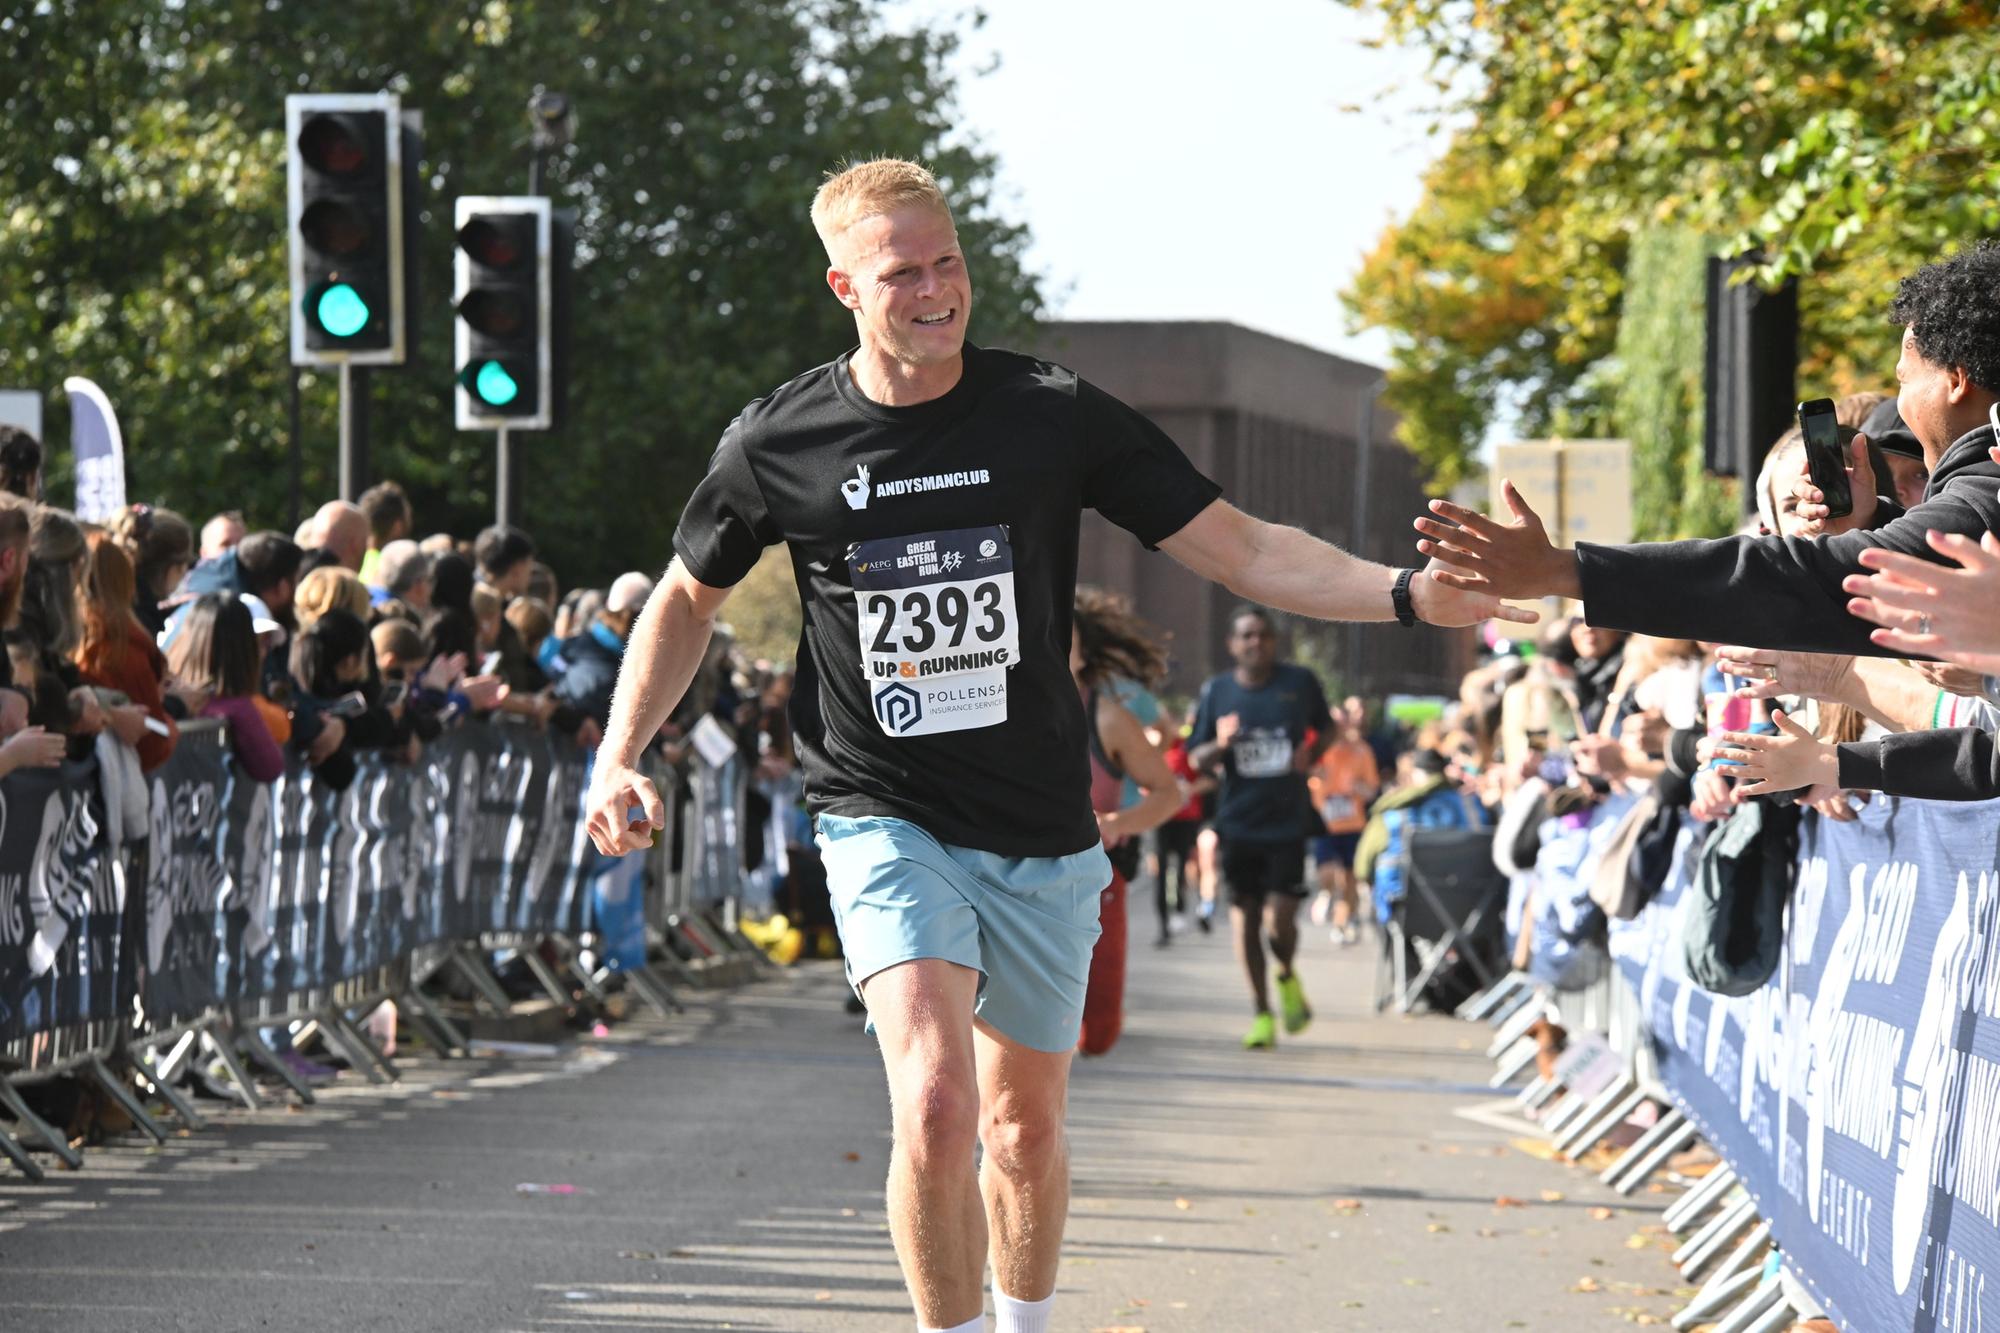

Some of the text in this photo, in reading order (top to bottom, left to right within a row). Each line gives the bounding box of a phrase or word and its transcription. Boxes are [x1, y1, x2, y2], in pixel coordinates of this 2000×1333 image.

[876, 469, 990, 498] ANDYSMANCLUB
[897, 551, 938, 568] EASTERN
[906, 540, 936, 554] GREAT
[869, 560, 891, 569] AEPG
[919, 563, 939, 577] RUN
[868, 582, 1006, 653] 2393
[873, 648, 1009, 678] UP & RUNNING
[928, 683, 1005, 704] POLLENSA
[929, 703, 972, 715] INSURANCE
[1855, 861, 1919, 984] GOOD
[1961, 870, 2000, 1018] GOO
[1822, 1169, 1872, 1267] EVENTS
